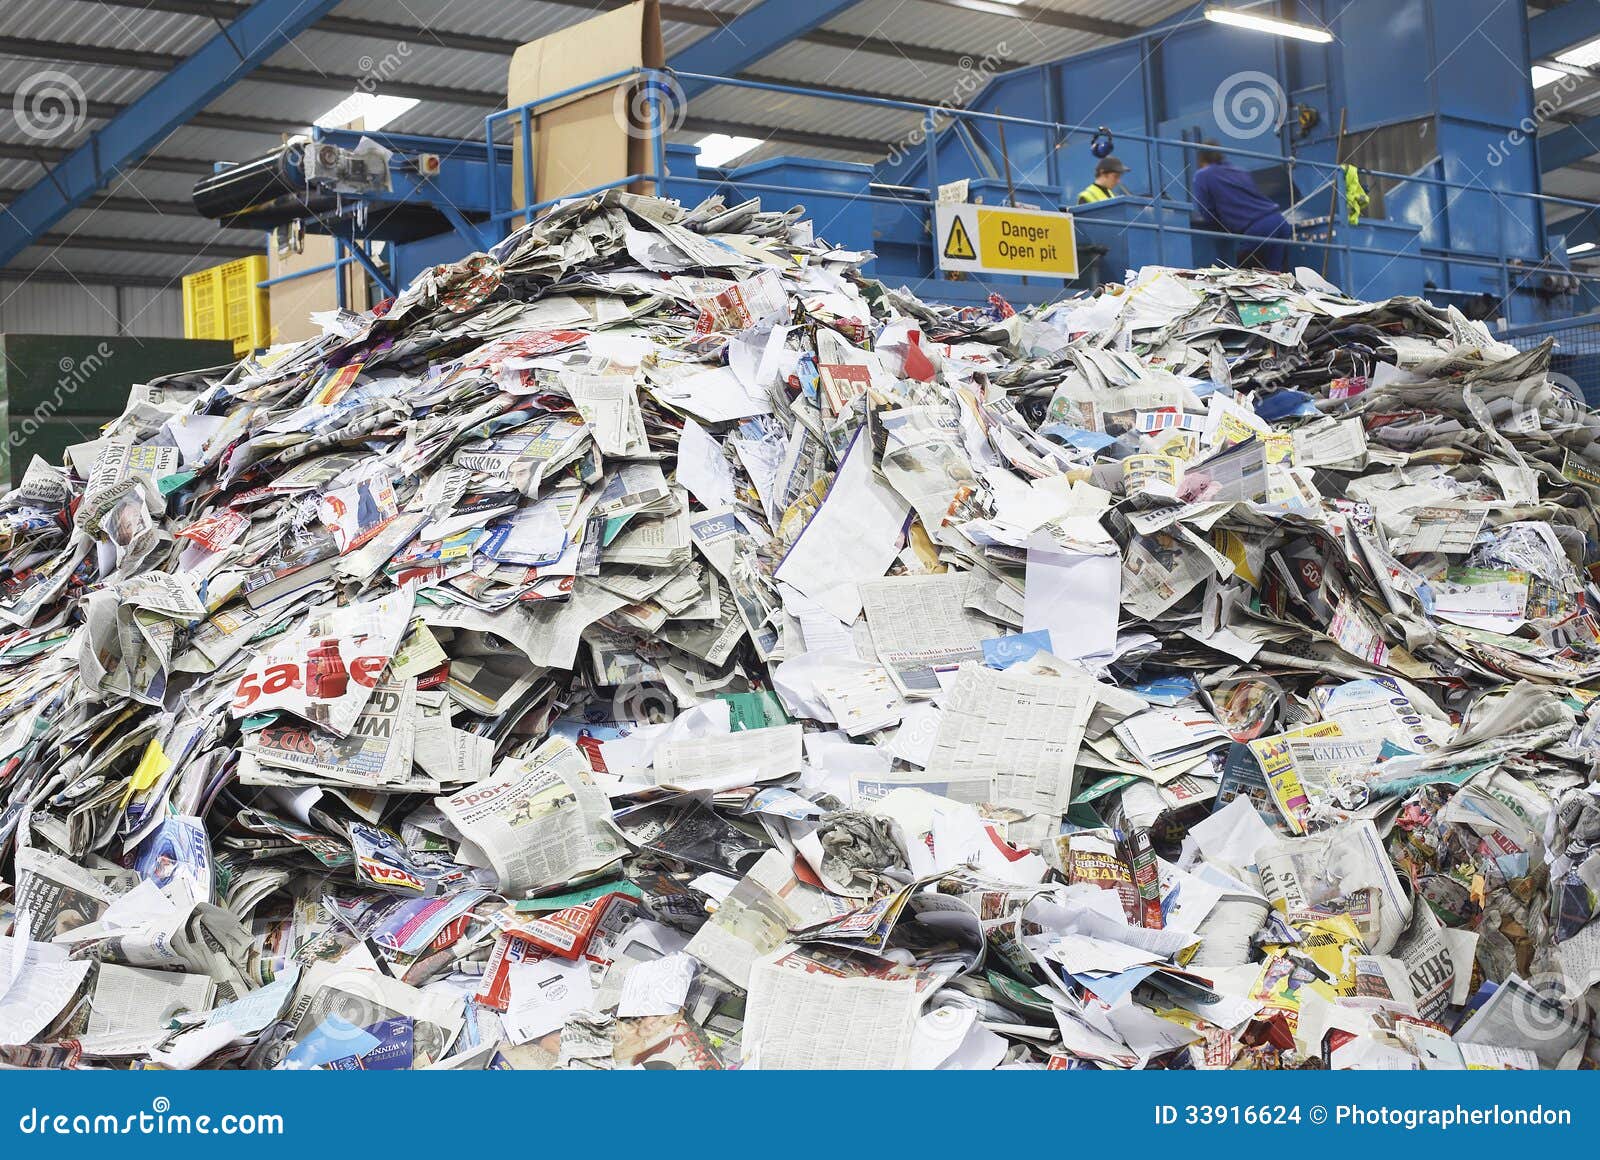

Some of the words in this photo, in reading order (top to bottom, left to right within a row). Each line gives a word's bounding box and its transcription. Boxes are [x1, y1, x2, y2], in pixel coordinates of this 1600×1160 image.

[1002, 221, 1049, 242] Danger
[999, 241, 1035, 260] Open
[1040, 241, 1057, 261] pit
[94, 475, 139, 505] EXPRESS
[697, 521, 727, 540] jobs
[1313, 746, 1369, 761] GAZETTE
[450, 781, 512, 807] Sport
[862, 783, 890, 797] job
[1075, 868, 1132, 882] DEALS
[556, 910, 584, 922] SALE
